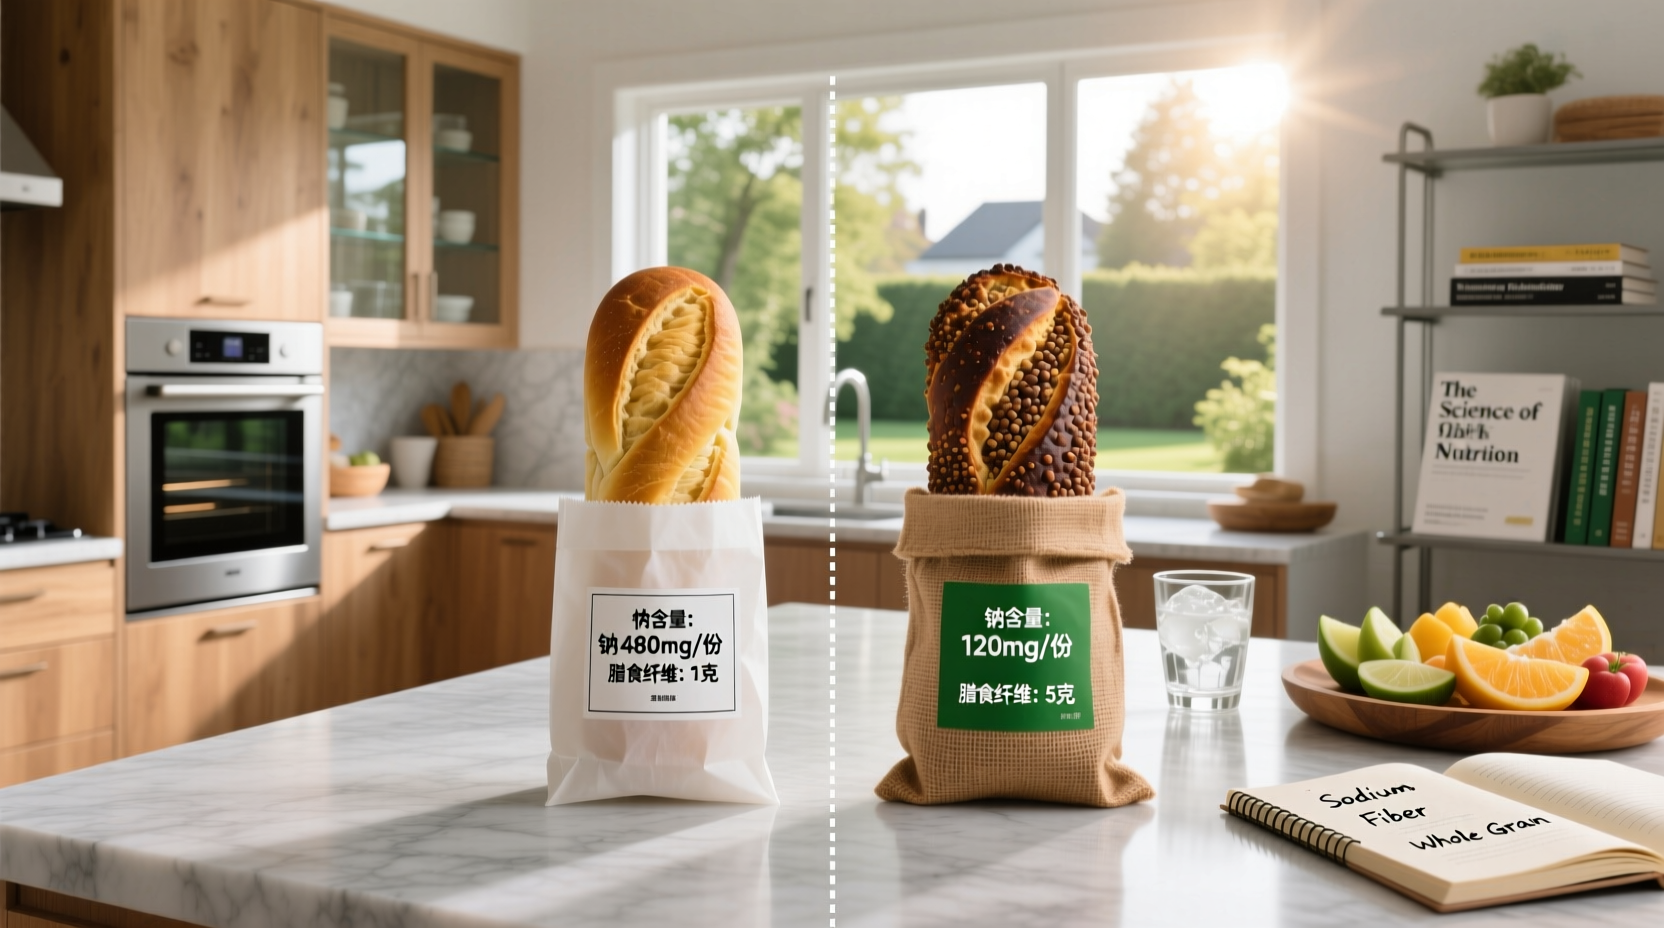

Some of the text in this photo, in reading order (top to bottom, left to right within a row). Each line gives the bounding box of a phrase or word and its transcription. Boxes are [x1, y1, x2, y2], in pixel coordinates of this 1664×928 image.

[1441, 380, 1477, 398] The
[1439, 401, 1543, 421] Science of
[961, 633, 1073, 663] 120mg/份
[1358, 807, 1426, 827] Fiber
